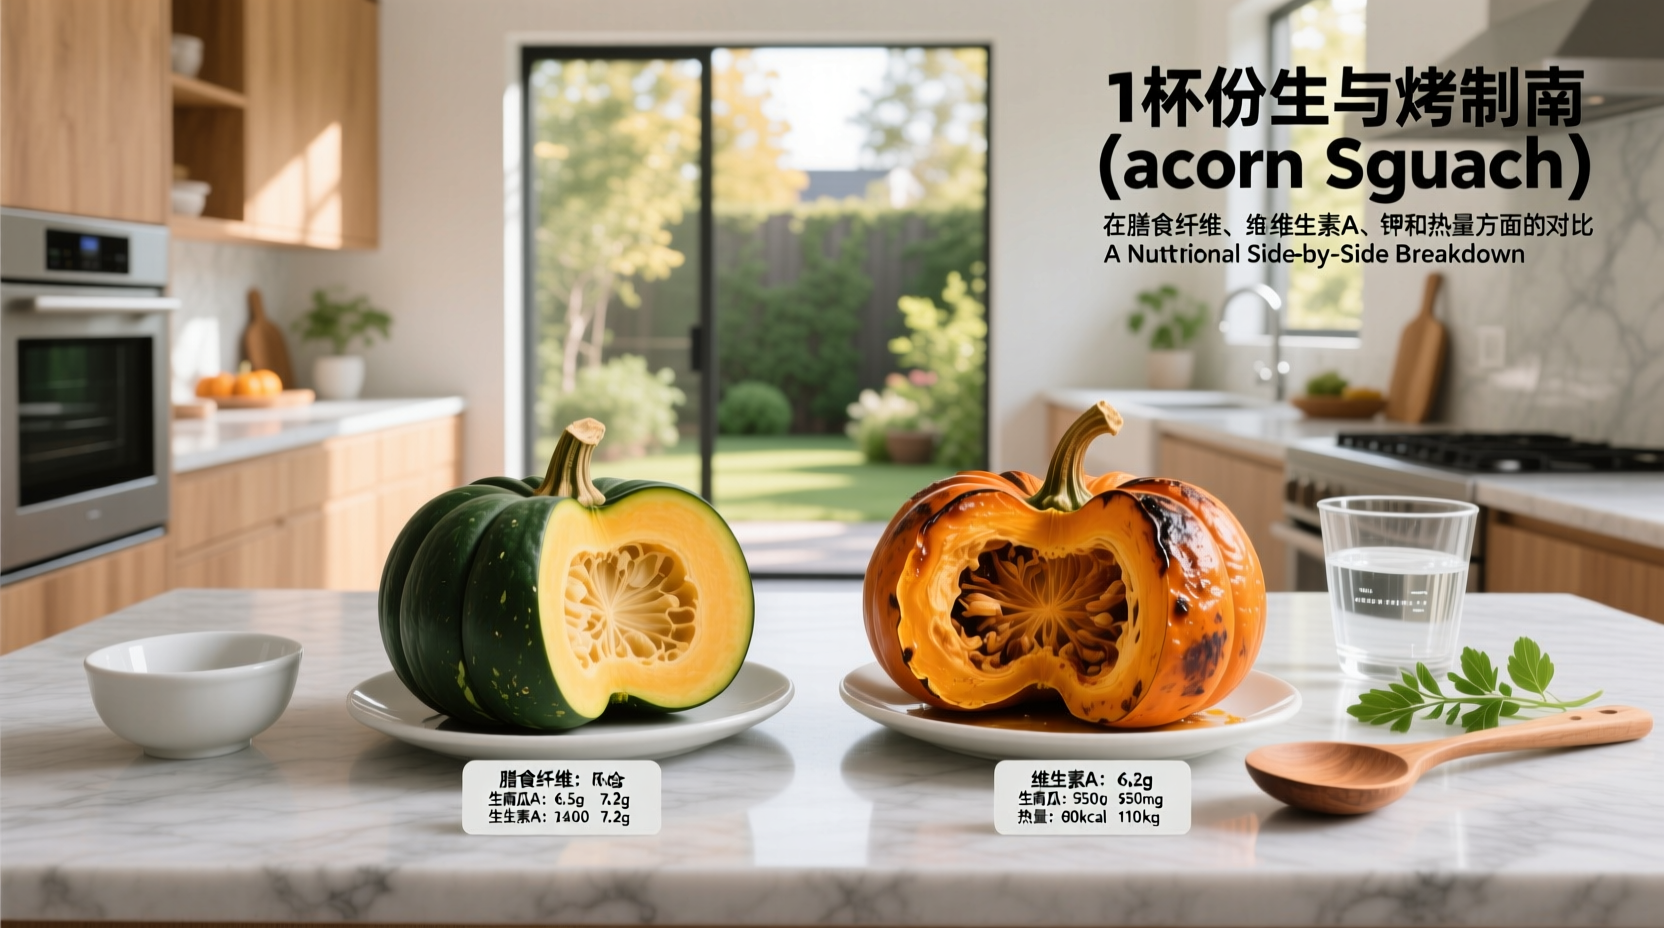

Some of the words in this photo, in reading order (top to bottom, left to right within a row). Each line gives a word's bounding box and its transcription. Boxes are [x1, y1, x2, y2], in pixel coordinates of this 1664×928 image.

[554, 792, 585, 808] 6.5g
[600, 791, 630, 809] 7.2g
[600, 809, 630, 826] 7.2g
[1118, 809, 1160, 827] 110kg
